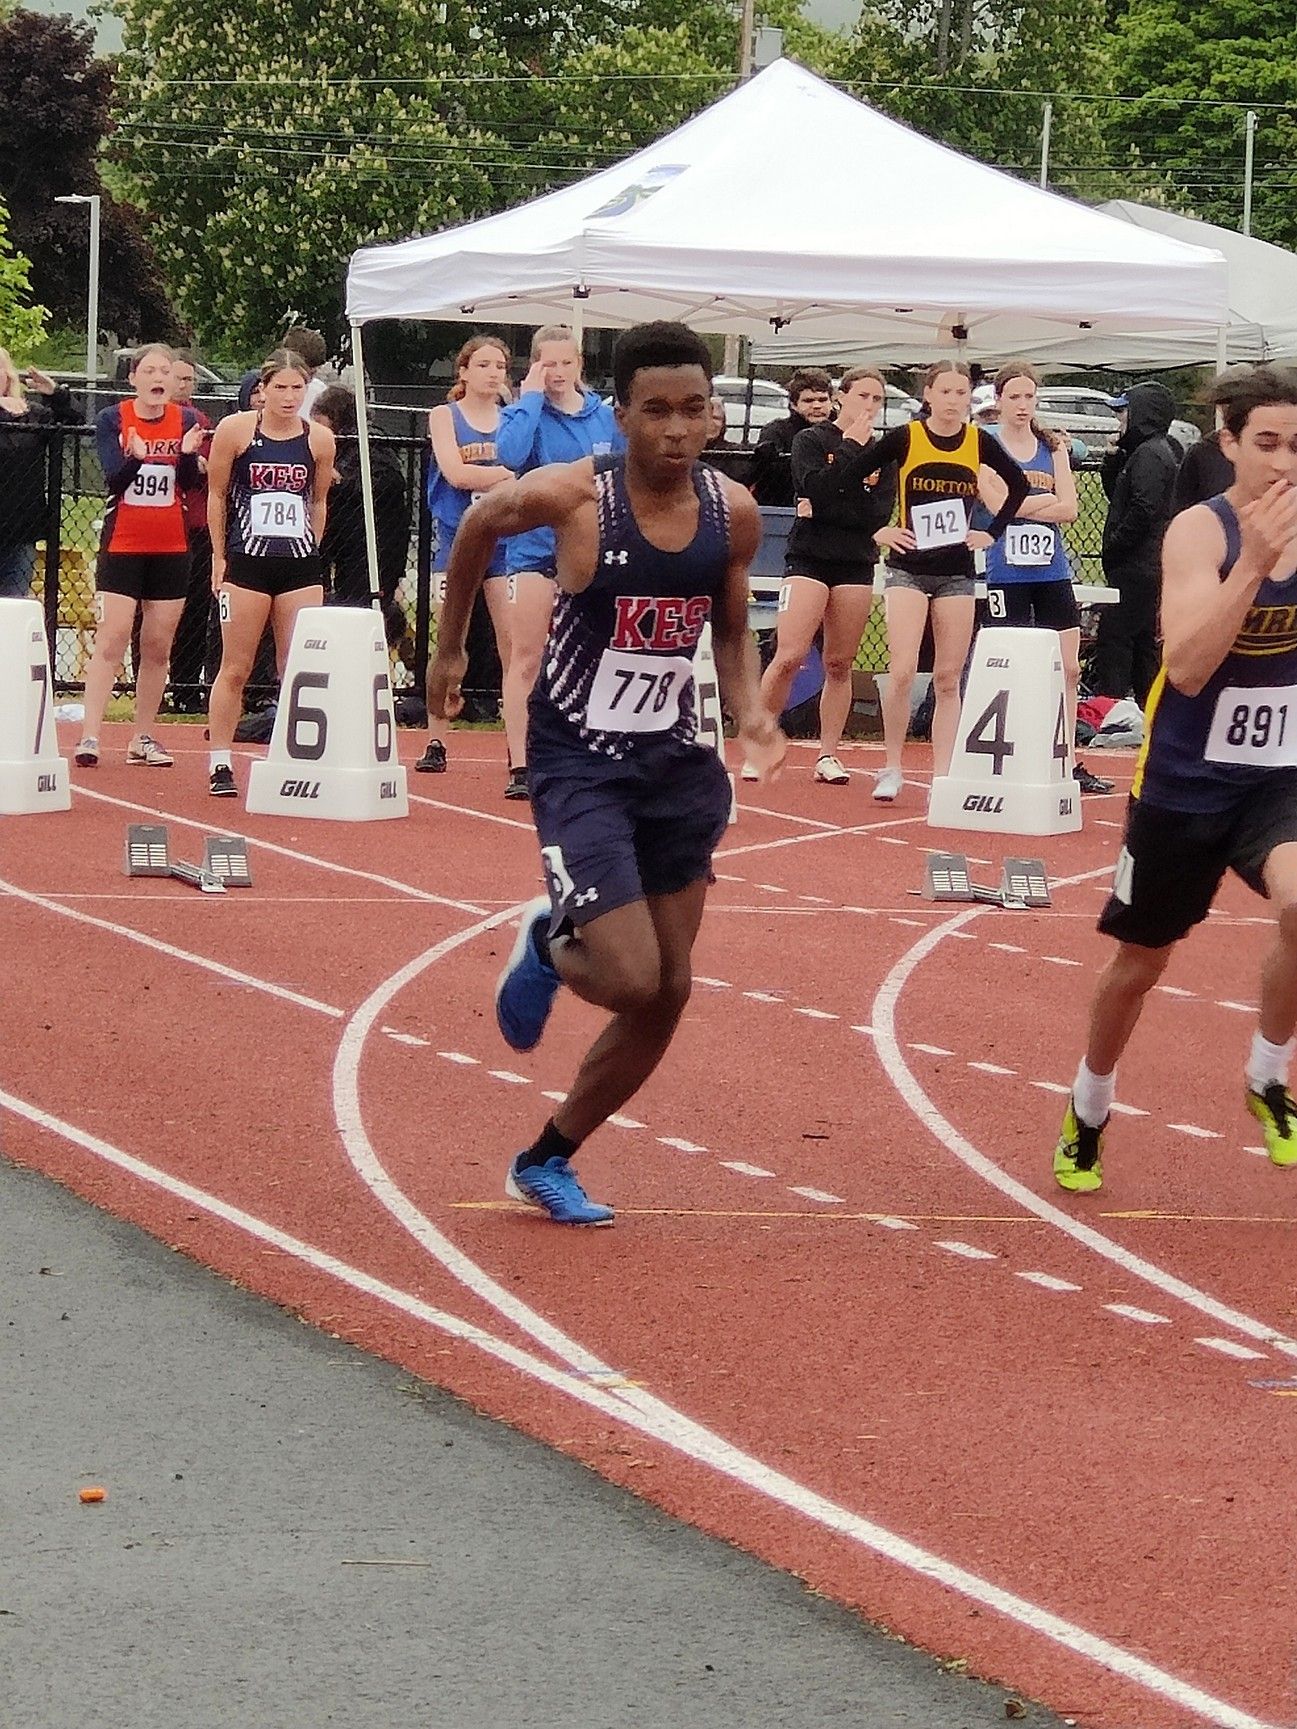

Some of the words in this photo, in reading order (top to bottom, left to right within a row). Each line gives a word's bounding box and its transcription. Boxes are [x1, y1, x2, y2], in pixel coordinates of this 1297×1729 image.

[133, 474, 168, 496] 994
[249, 463, 308, 492] KES
[913, 477, 978, 496] HORTON
[261, 502, 297, 526] 784
[921, 510, 959, 537] 742
[1009, 534, 1052, 556] 1032
[990, 592, 1001, 615] 3
[610, 595, 713, 650] KES
[304, 639, 328, 650] GILL
[986, 658, 1010, 668] GILL
[609, 669, 676, 714] 778
[31, 665, 47, 755] 7
[287, 671, 330, 760] 6
[373, 673, 391, 762] 6
[965, 690, 1014, 776] 4
[1053, 693, 1068, 778] 4
[1227, 704, 1288, 747] 891
[38, 774, 56, 792] GILL
[280, 780, 322, 799] GILL
[380, 781, 397, 799] GILL
[962, 794, 1004, 813] GILL
